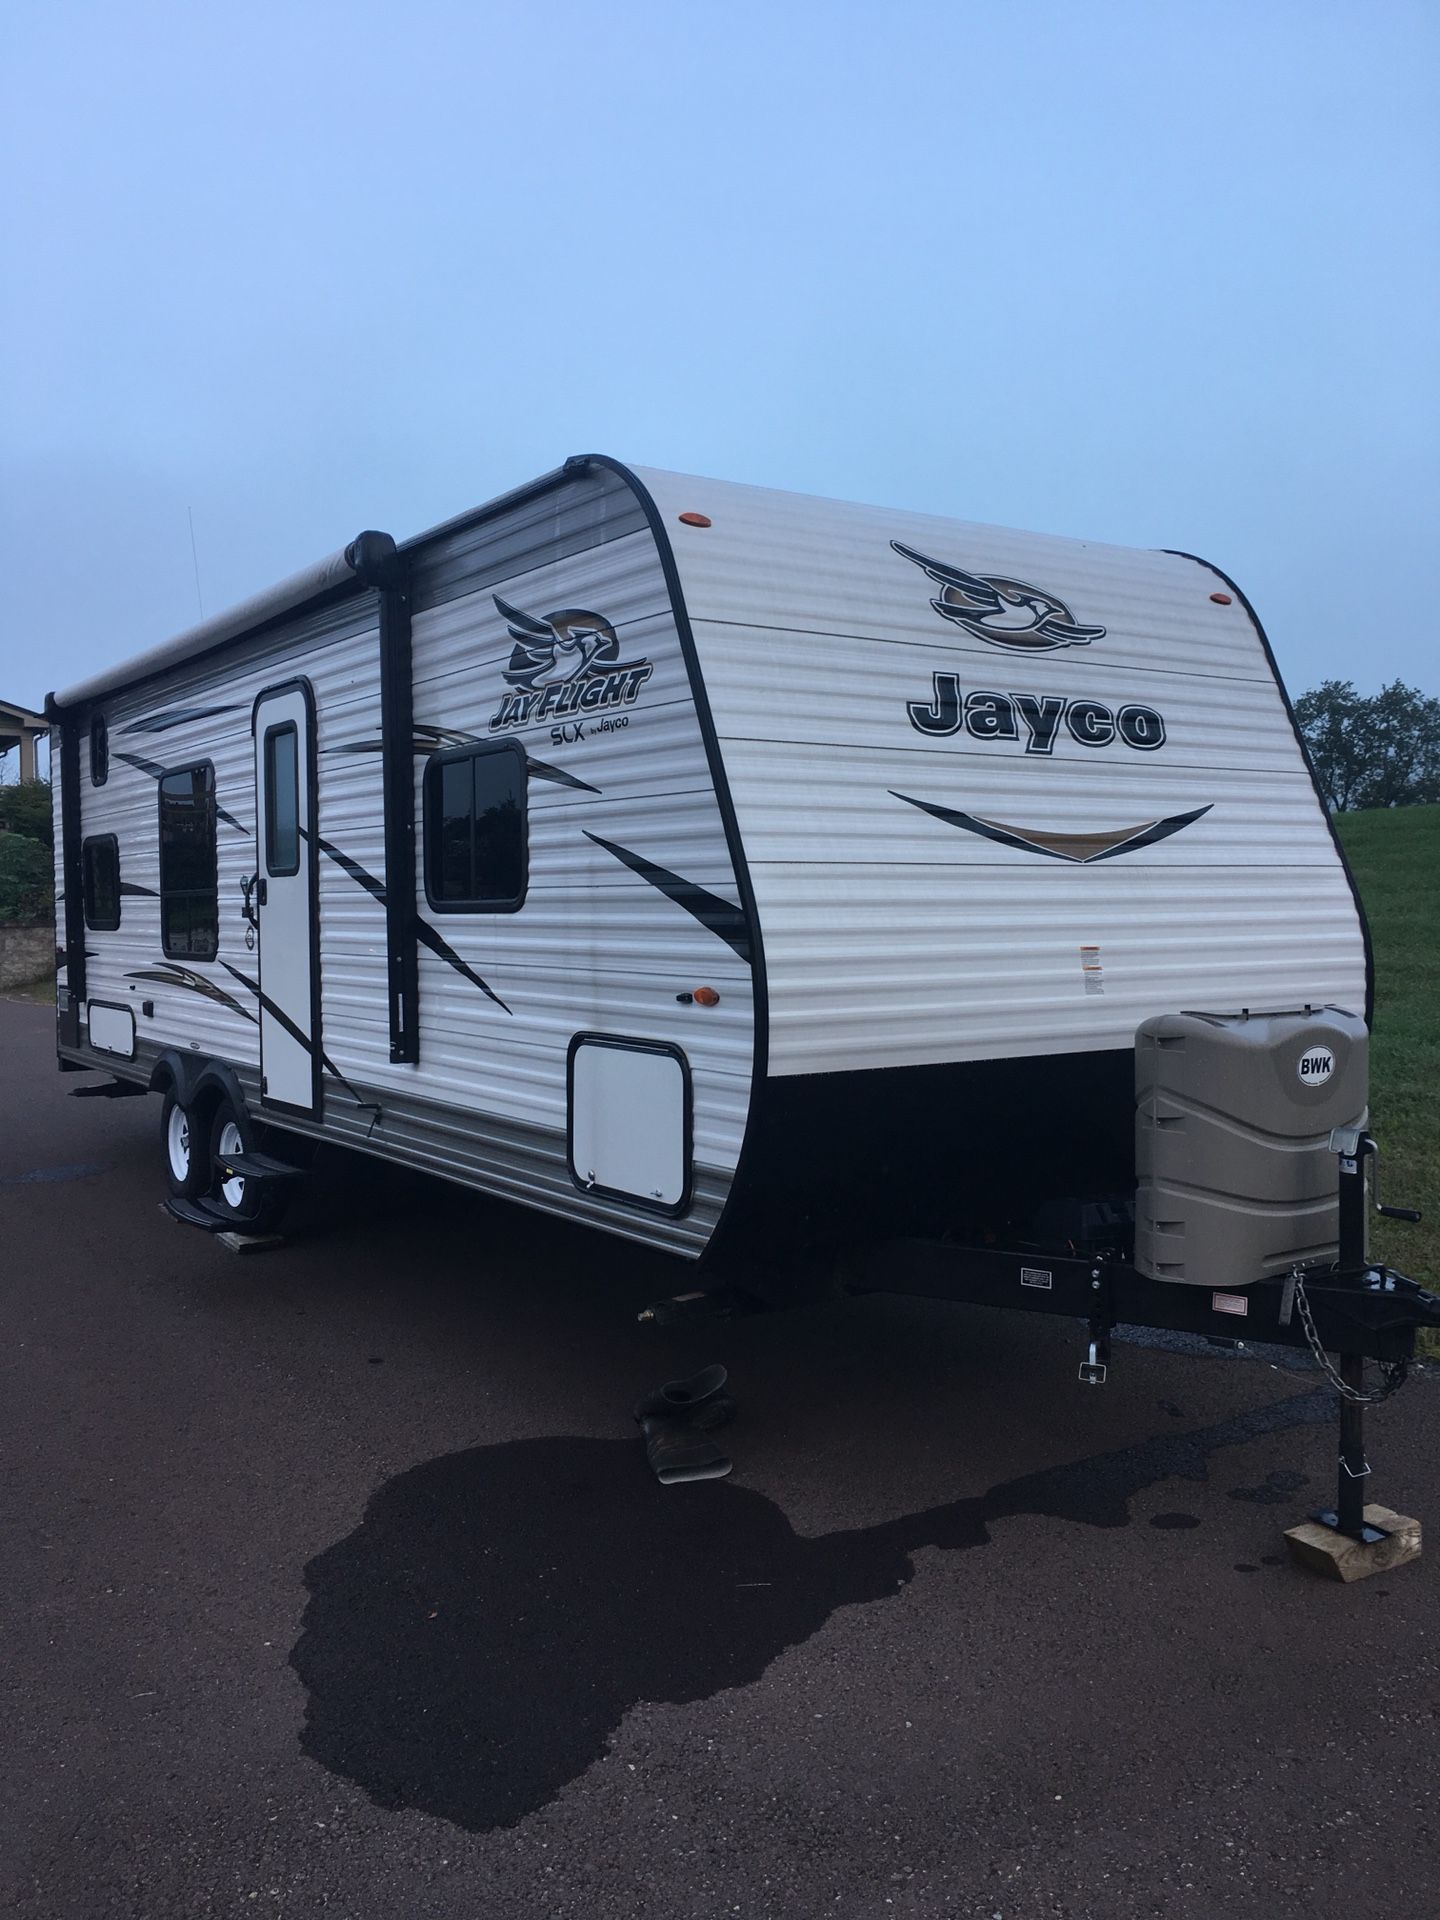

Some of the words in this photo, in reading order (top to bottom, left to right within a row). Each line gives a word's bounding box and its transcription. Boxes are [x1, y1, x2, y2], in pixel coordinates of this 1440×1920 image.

[906, 671, 1167, 755] Jayco
[550, 722, 586, 747] SLX
[597, 716, 629, 733] Jayco
[1300, 1056, 1332, 1075] BWK
